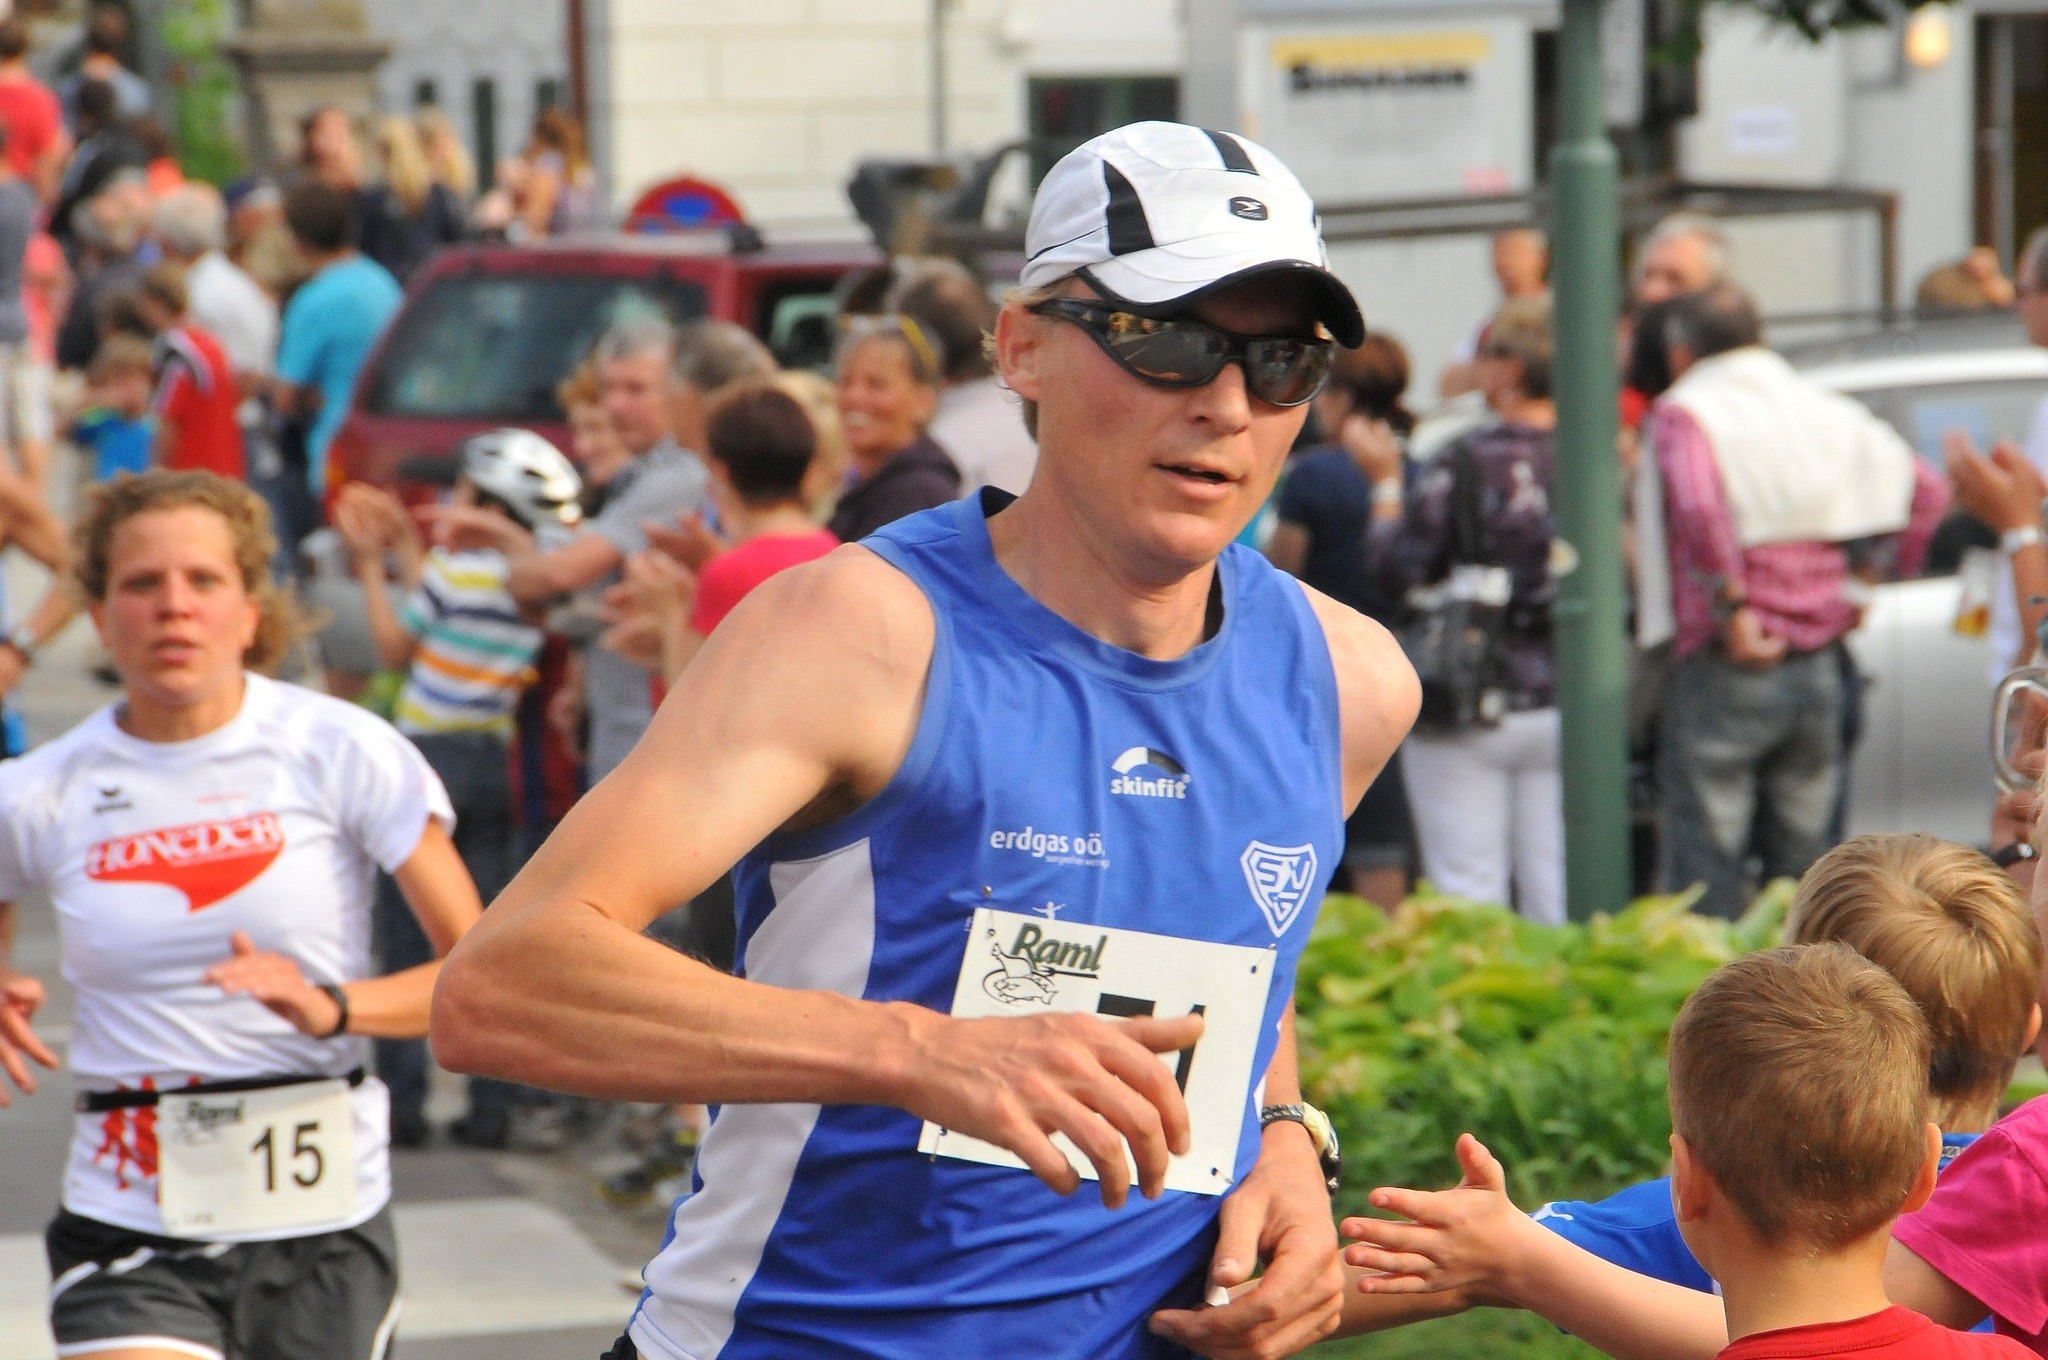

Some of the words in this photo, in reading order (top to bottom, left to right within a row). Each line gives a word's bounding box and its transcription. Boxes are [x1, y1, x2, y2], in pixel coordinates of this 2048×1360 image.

[1110, 775, 1187, 799] skinfit
[989, 825, 1070, 858] erdgas
[1010, 922, 1107, 971] Raml
[251, 1120, 324, 1193] 15
